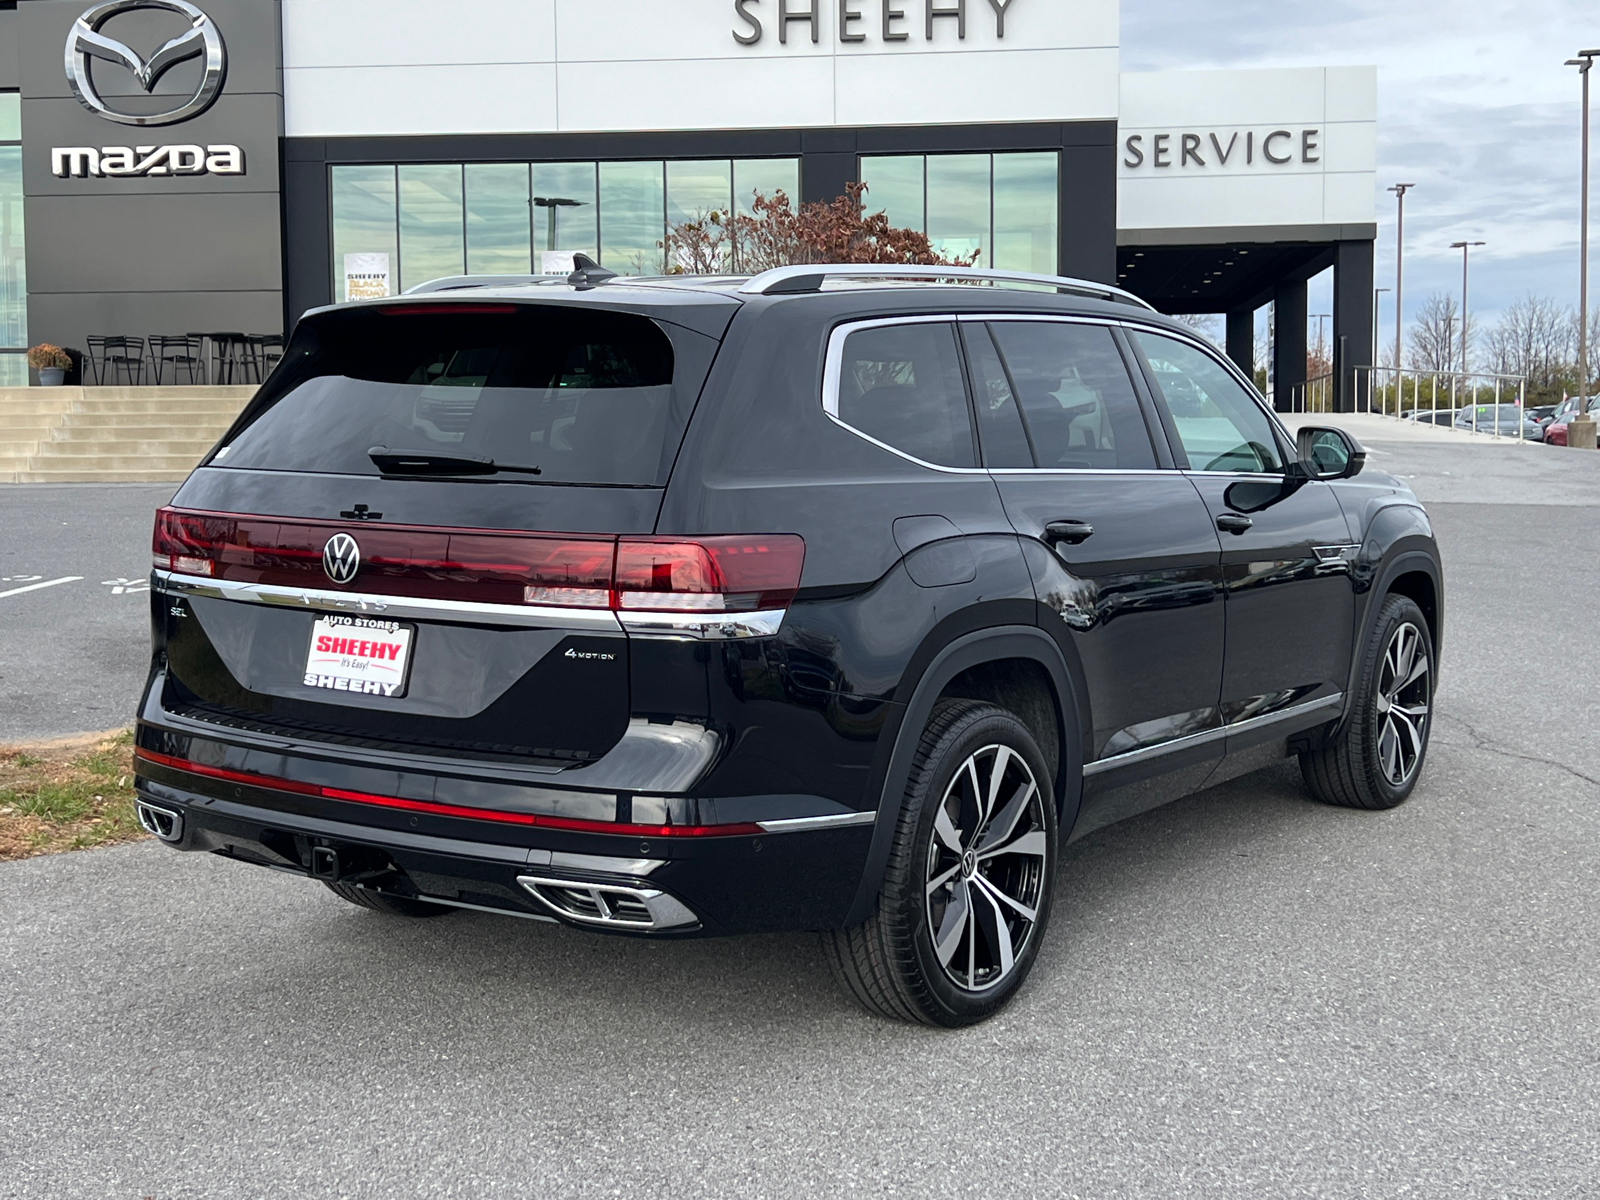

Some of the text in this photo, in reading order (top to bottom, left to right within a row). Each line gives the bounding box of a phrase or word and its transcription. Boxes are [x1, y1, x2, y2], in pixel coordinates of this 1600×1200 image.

[732, 0, 1015, 45] SHEEHY
[1124, 129, 1320, 168] SERVICE
[348, 280, 385, 288] BLACK
[348, 288, 388, 298] FRIDAY
[299, 593, 388, 611] ATLAS
[322, 615, 400, 631] AUTO STORES
[316, 635, 402, 661] SHEEHY
[564, 647, 616, 660] 4MOTION
[341, 657, 370, 672] It's Easy!
[303, 673, 400, 697] SHEEHY
